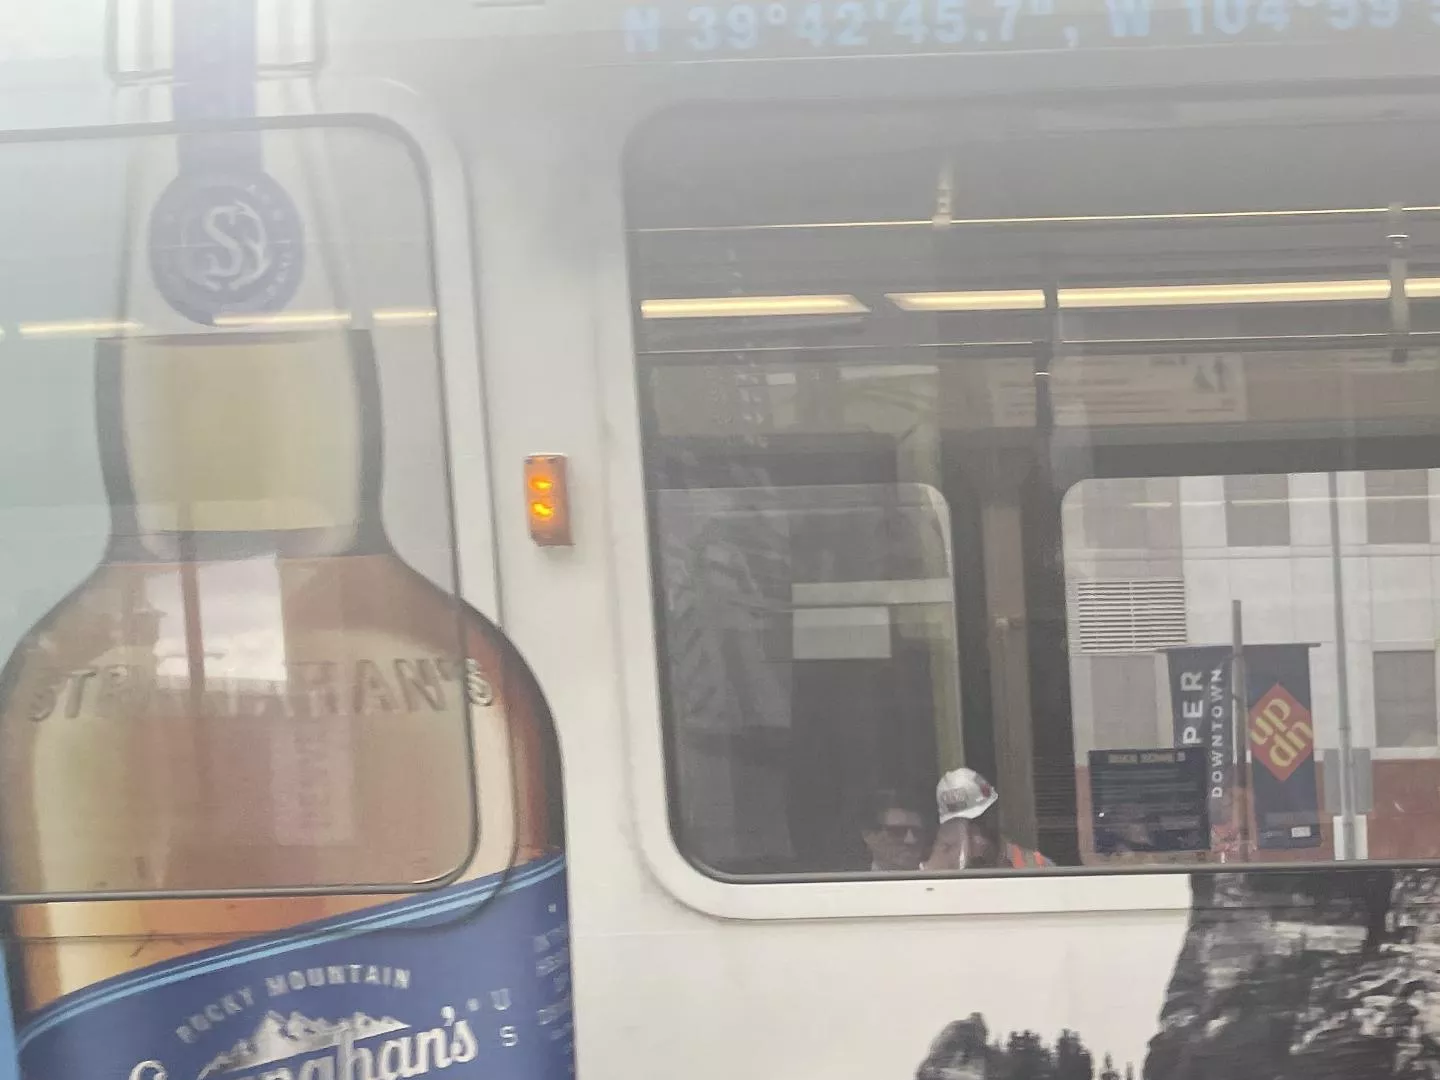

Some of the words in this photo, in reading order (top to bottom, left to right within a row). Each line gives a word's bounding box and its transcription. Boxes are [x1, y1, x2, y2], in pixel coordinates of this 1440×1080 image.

[622, 6, 660, 53] N
[1106, 0, 1151, 38] W
[1210, 669, 1223, 798] DOWNTOWN
[263, 964, 412, 998] MOUNTAIN
